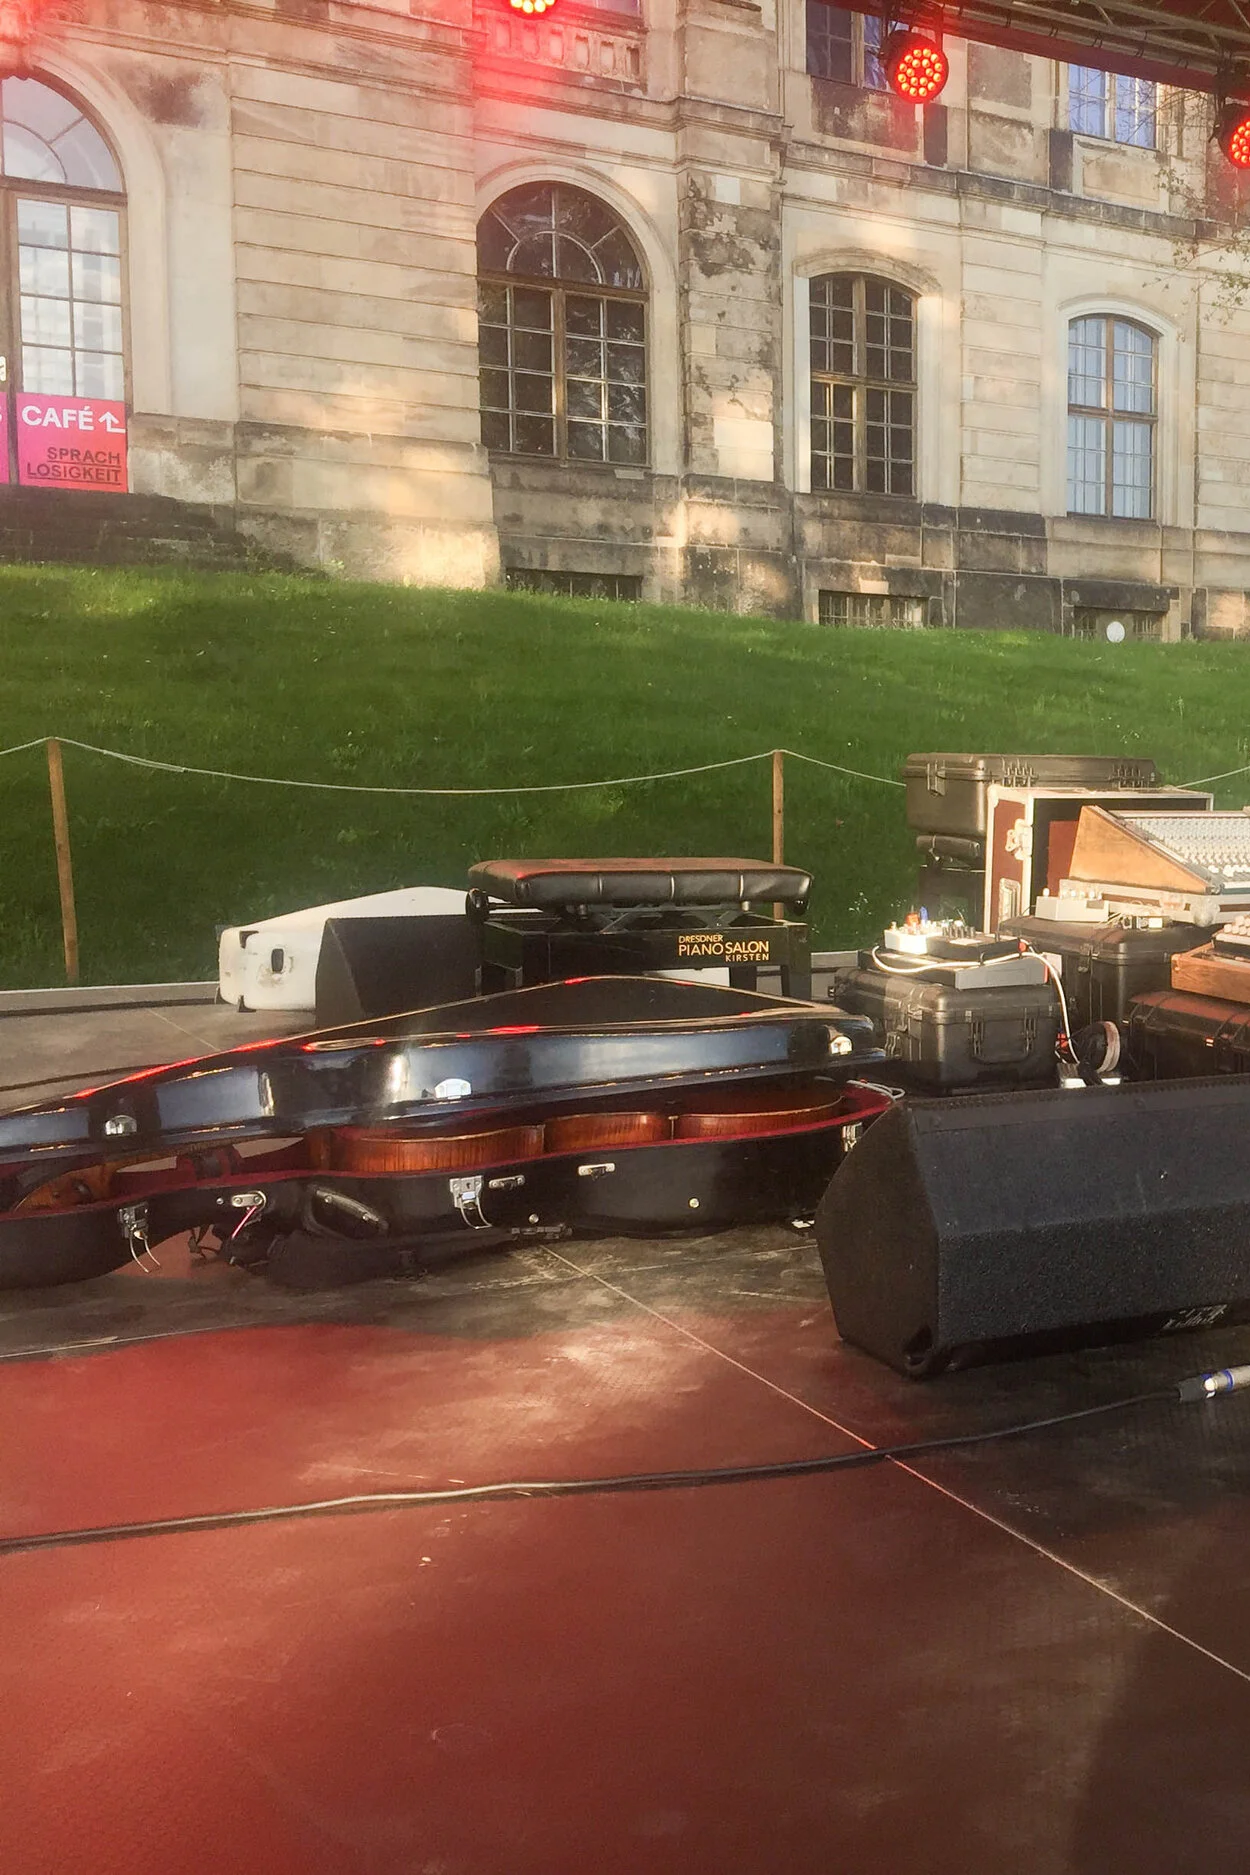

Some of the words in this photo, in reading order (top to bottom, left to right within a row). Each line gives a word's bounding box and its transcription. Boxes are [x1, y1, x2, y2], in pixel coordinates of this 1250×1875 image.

[21, 405, 94, 431] CAFÉ
[47, 446, 121, 463] SPRACH
[27, 463, 121, 482] LOSIGKEIT
[678, 934, 724, 944] DRESDNER
[725, 953, 769, 962] KIRSTEN
